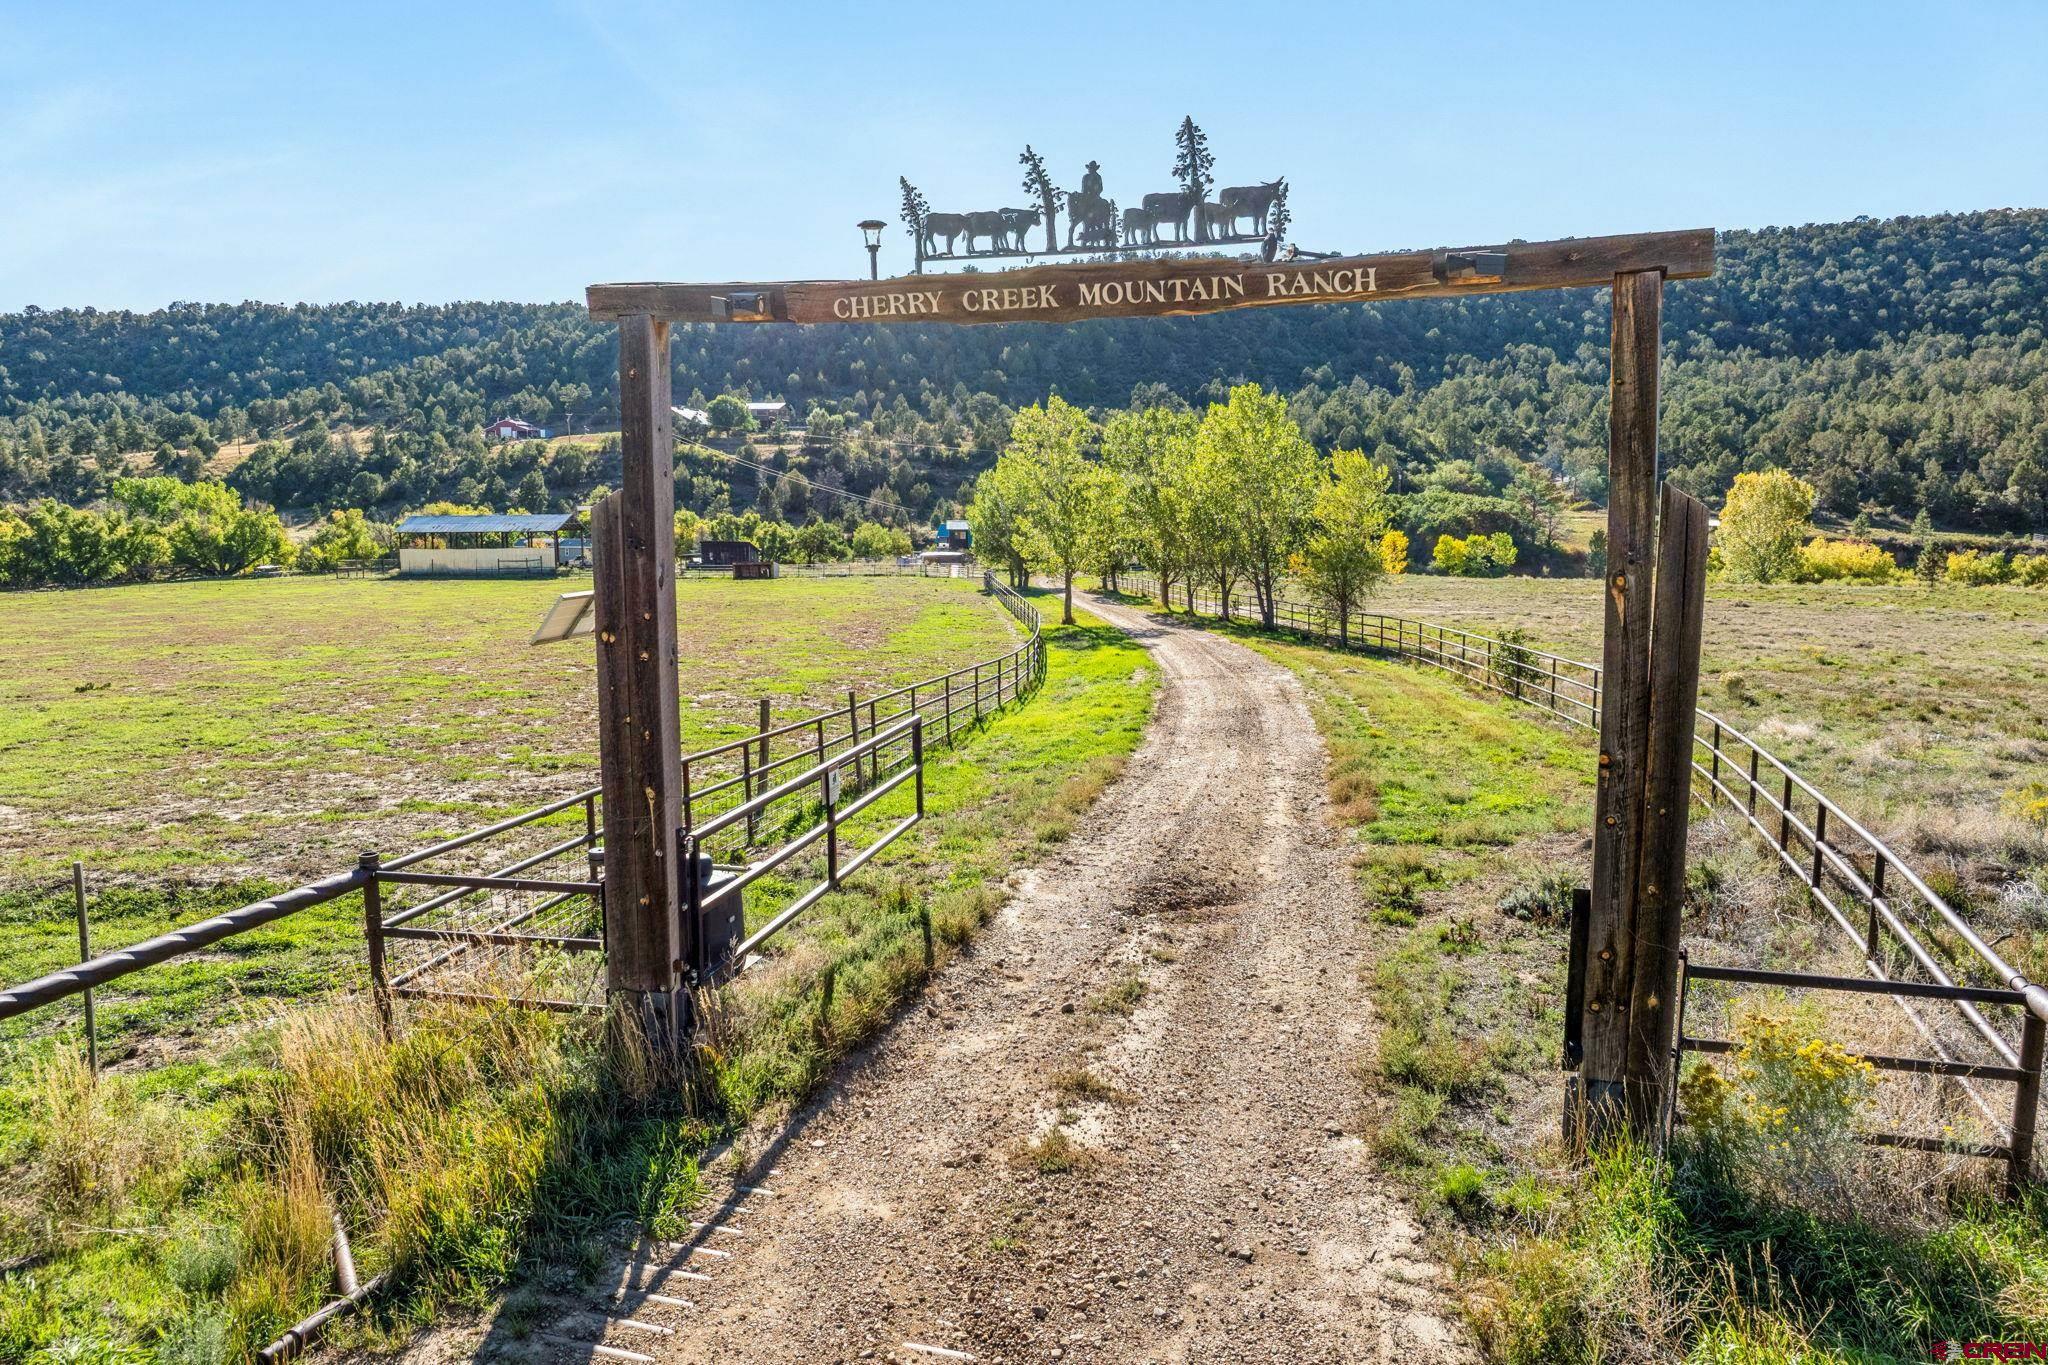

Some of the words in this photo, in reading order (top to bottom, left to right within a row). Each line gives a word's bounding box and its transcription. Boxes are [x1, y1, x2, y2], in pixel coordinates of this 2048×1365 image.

[833, 290, 942, 319] CHERRY
[962, 284, 1060, 312] CREEK
[1078, 273, 1245, 306] MOUNTAIN
[1266, 266, 1378, 297] RANCH
